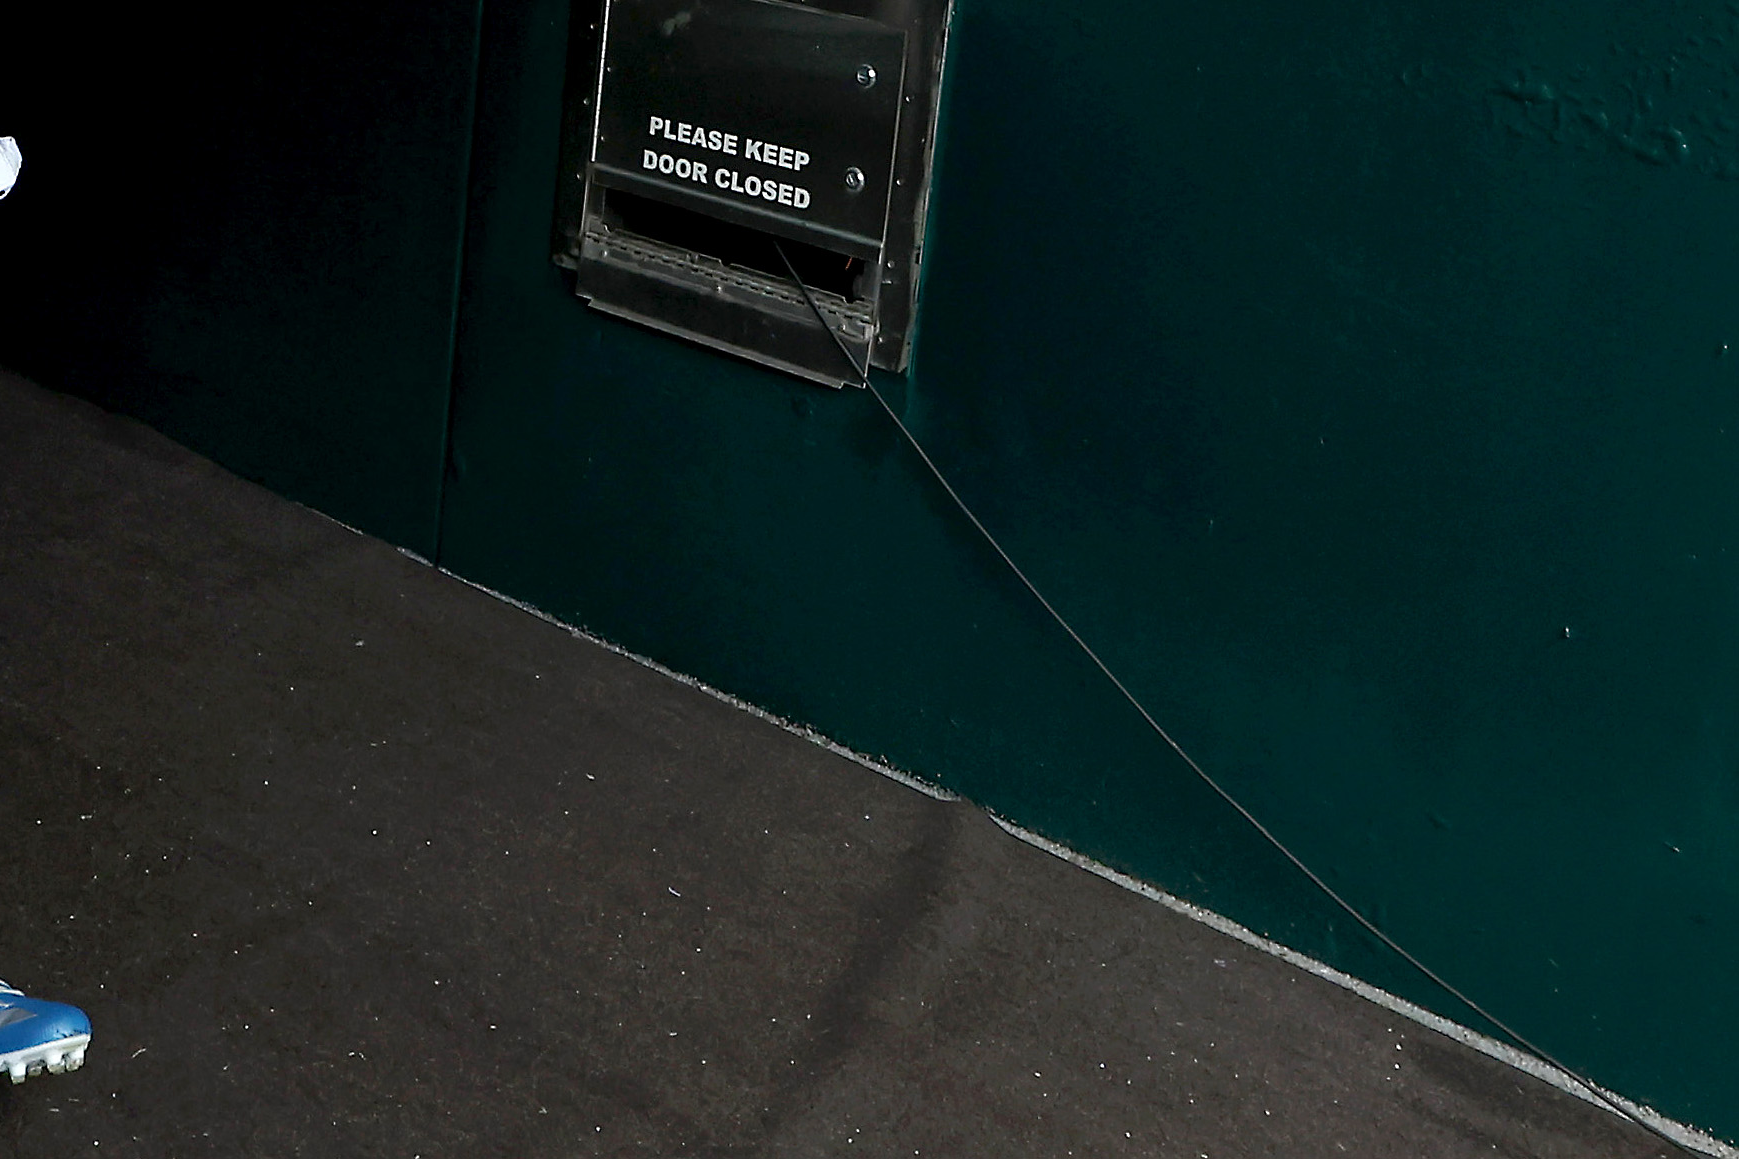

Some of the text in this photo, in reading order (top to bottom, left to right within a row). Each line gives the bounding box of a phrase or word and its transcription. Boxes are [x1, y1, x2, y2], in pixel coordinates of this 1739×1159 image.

[648, 115, 811, 172] PLEASE KEEP
[642, 148, 812, 210] DOOR CLOSED
